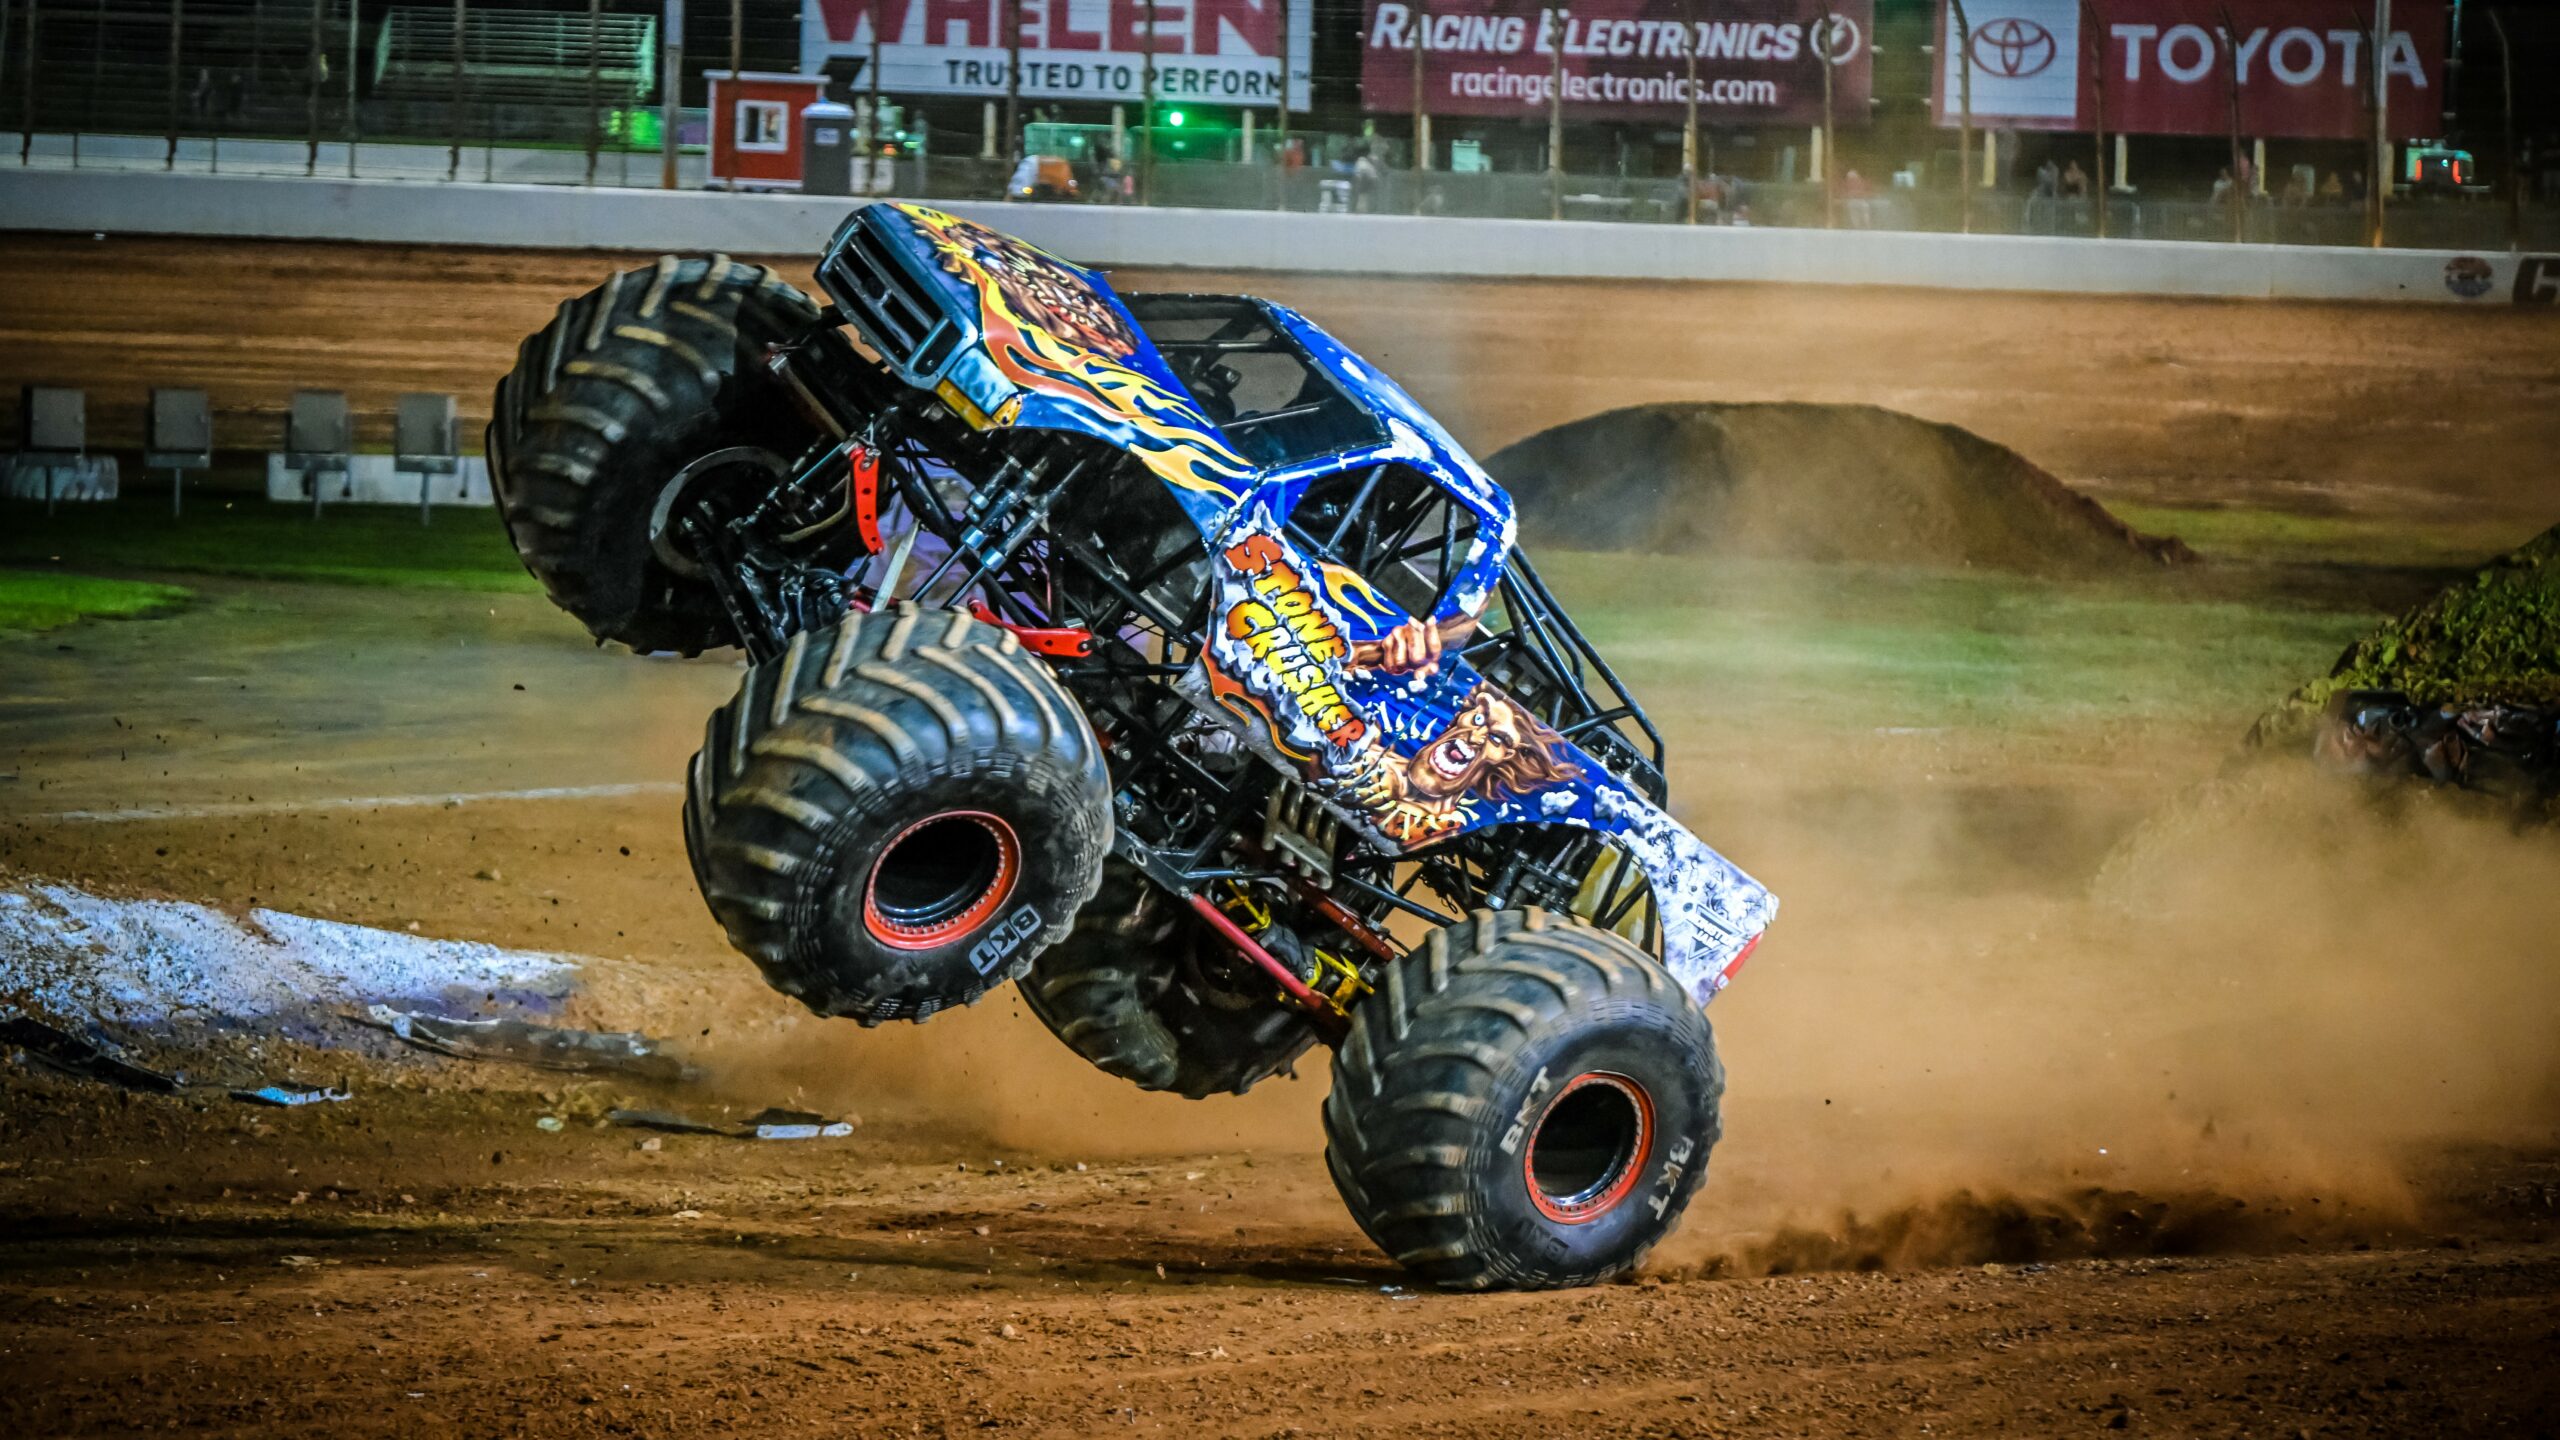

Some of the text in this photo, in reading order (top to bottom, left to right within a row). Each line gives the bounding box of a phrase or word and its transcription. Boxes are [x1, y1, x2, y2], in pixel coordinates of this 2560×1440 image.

[818, 0, 1284, 57] WHELEN
[1370, 3, 1802, 61] RACING ELECTRONICS
[2111, 24, 2428, 88] TOYOTA
[1094, 64, 1131, 90] TO
[1451, 66, 1777, 105] racingelectronics.com
[1224, 534, 1347, 664] STONE
[1226, 600, 1367, 748] CRUSHER
[969, 904, 1041, 975] BKT
[1500, 1066, 1550, 1155] BKT
